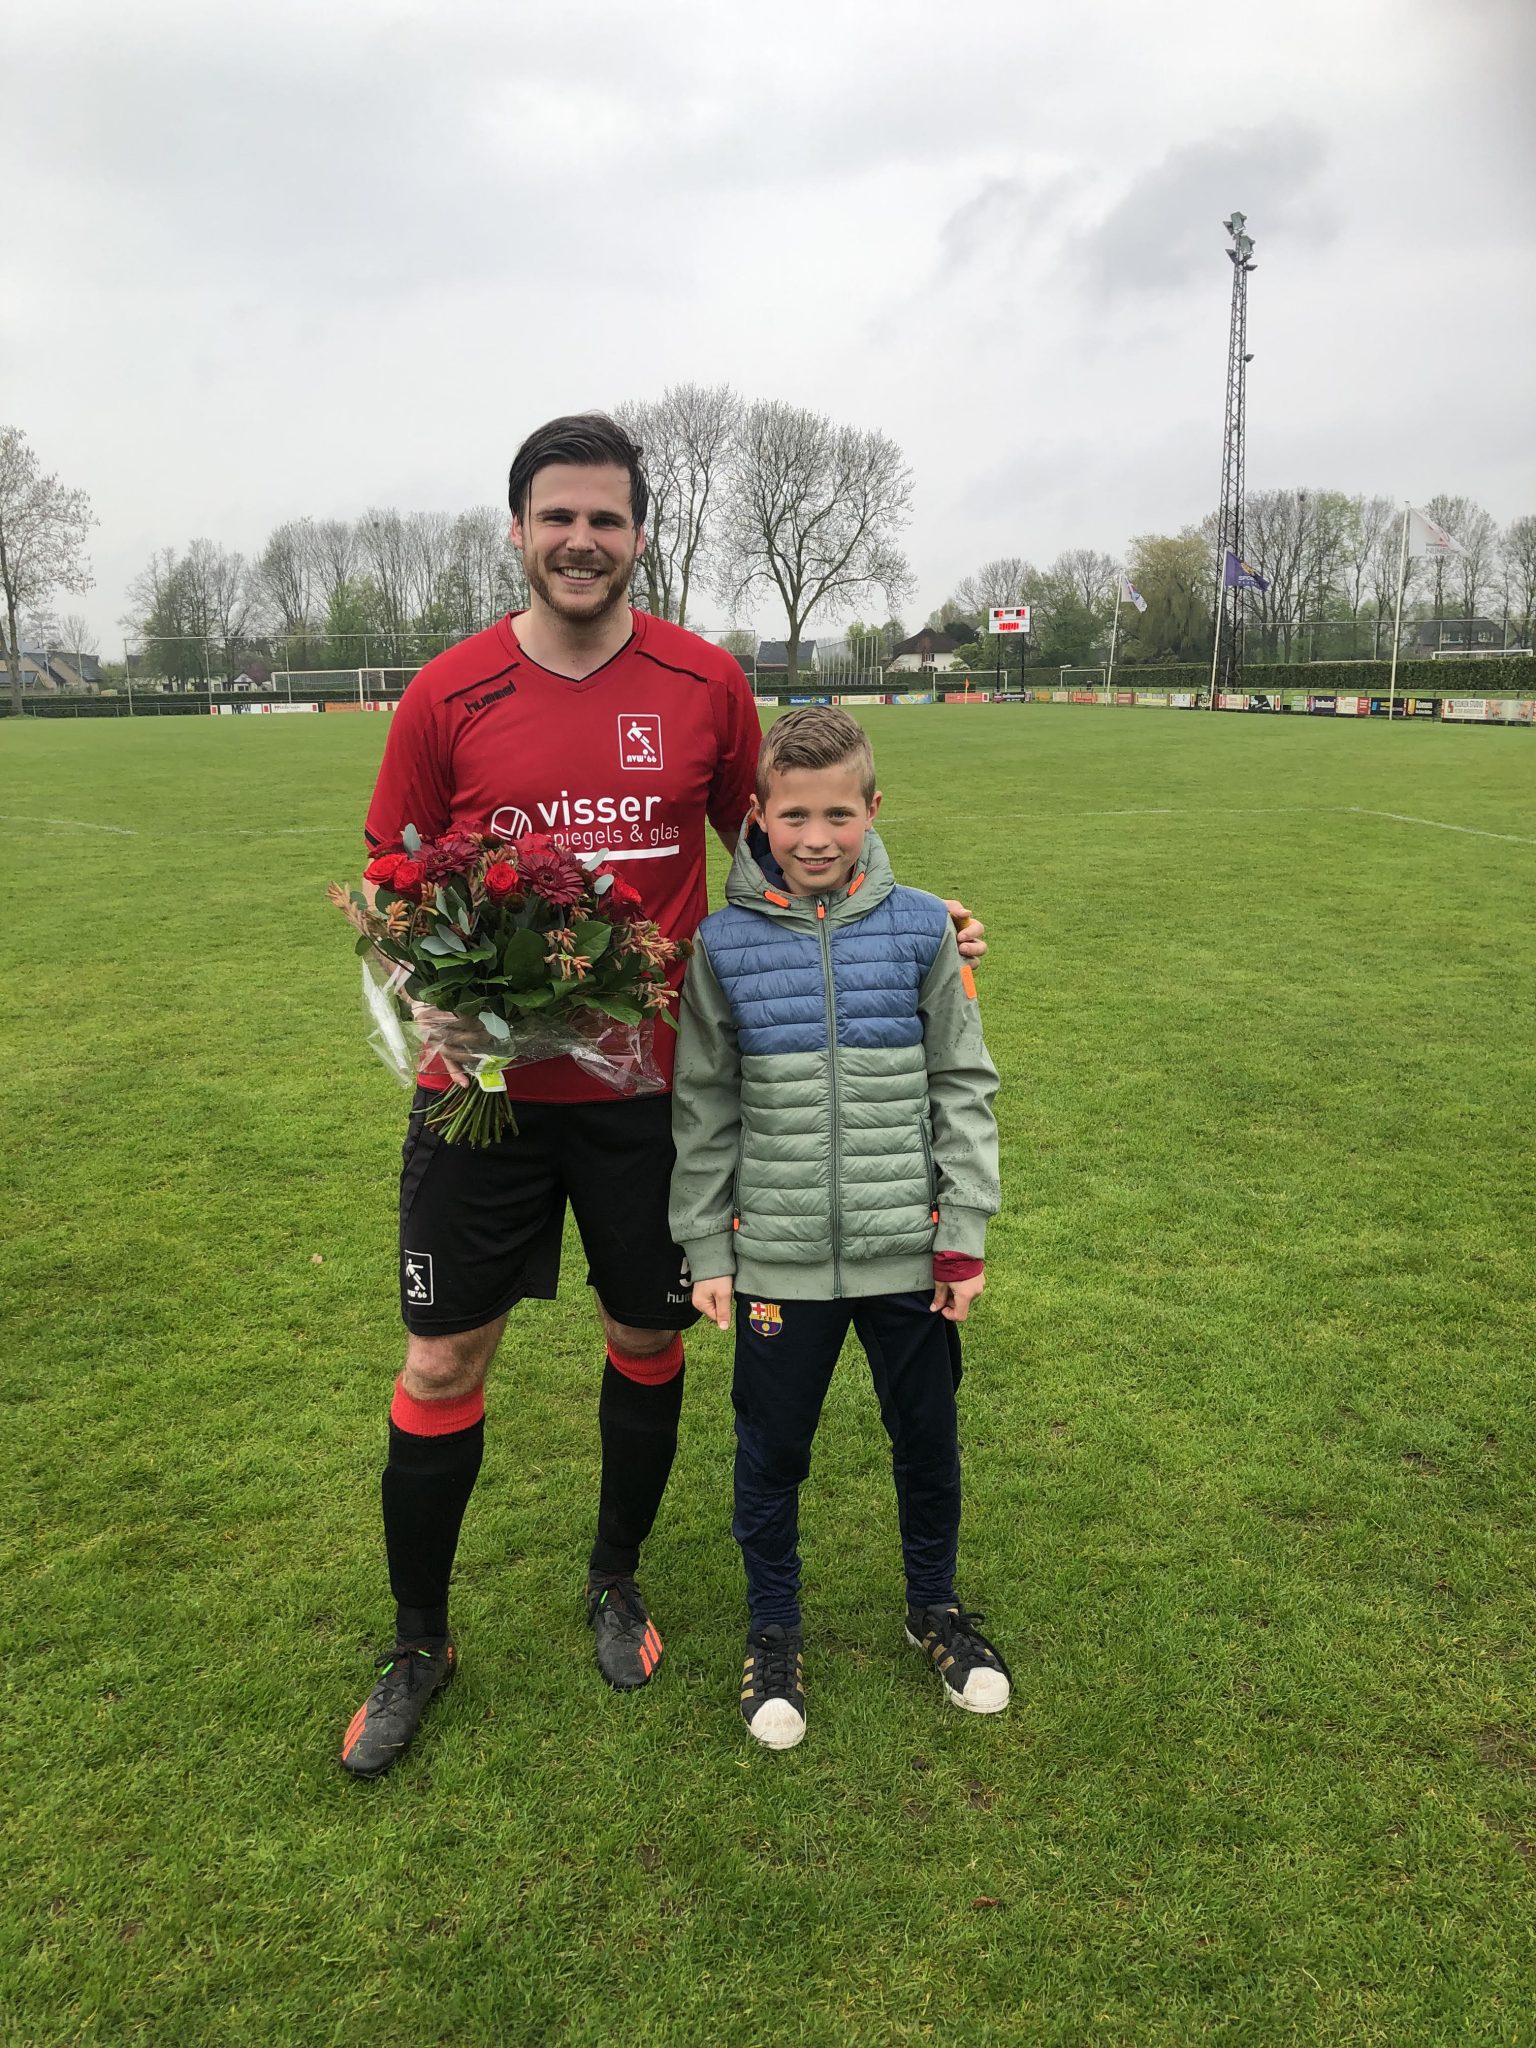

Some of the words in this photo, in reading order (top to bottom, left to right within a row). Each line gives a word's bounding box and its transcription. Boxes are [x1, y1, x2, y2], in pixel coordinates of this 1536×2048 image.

[464, 680, 517, 715] hummel
[536, 790, 662, 827] visser
[546, 825, 624, 851] piegels
[630, 824, 644, 843] &
[650, 822, 680, 846] glas
